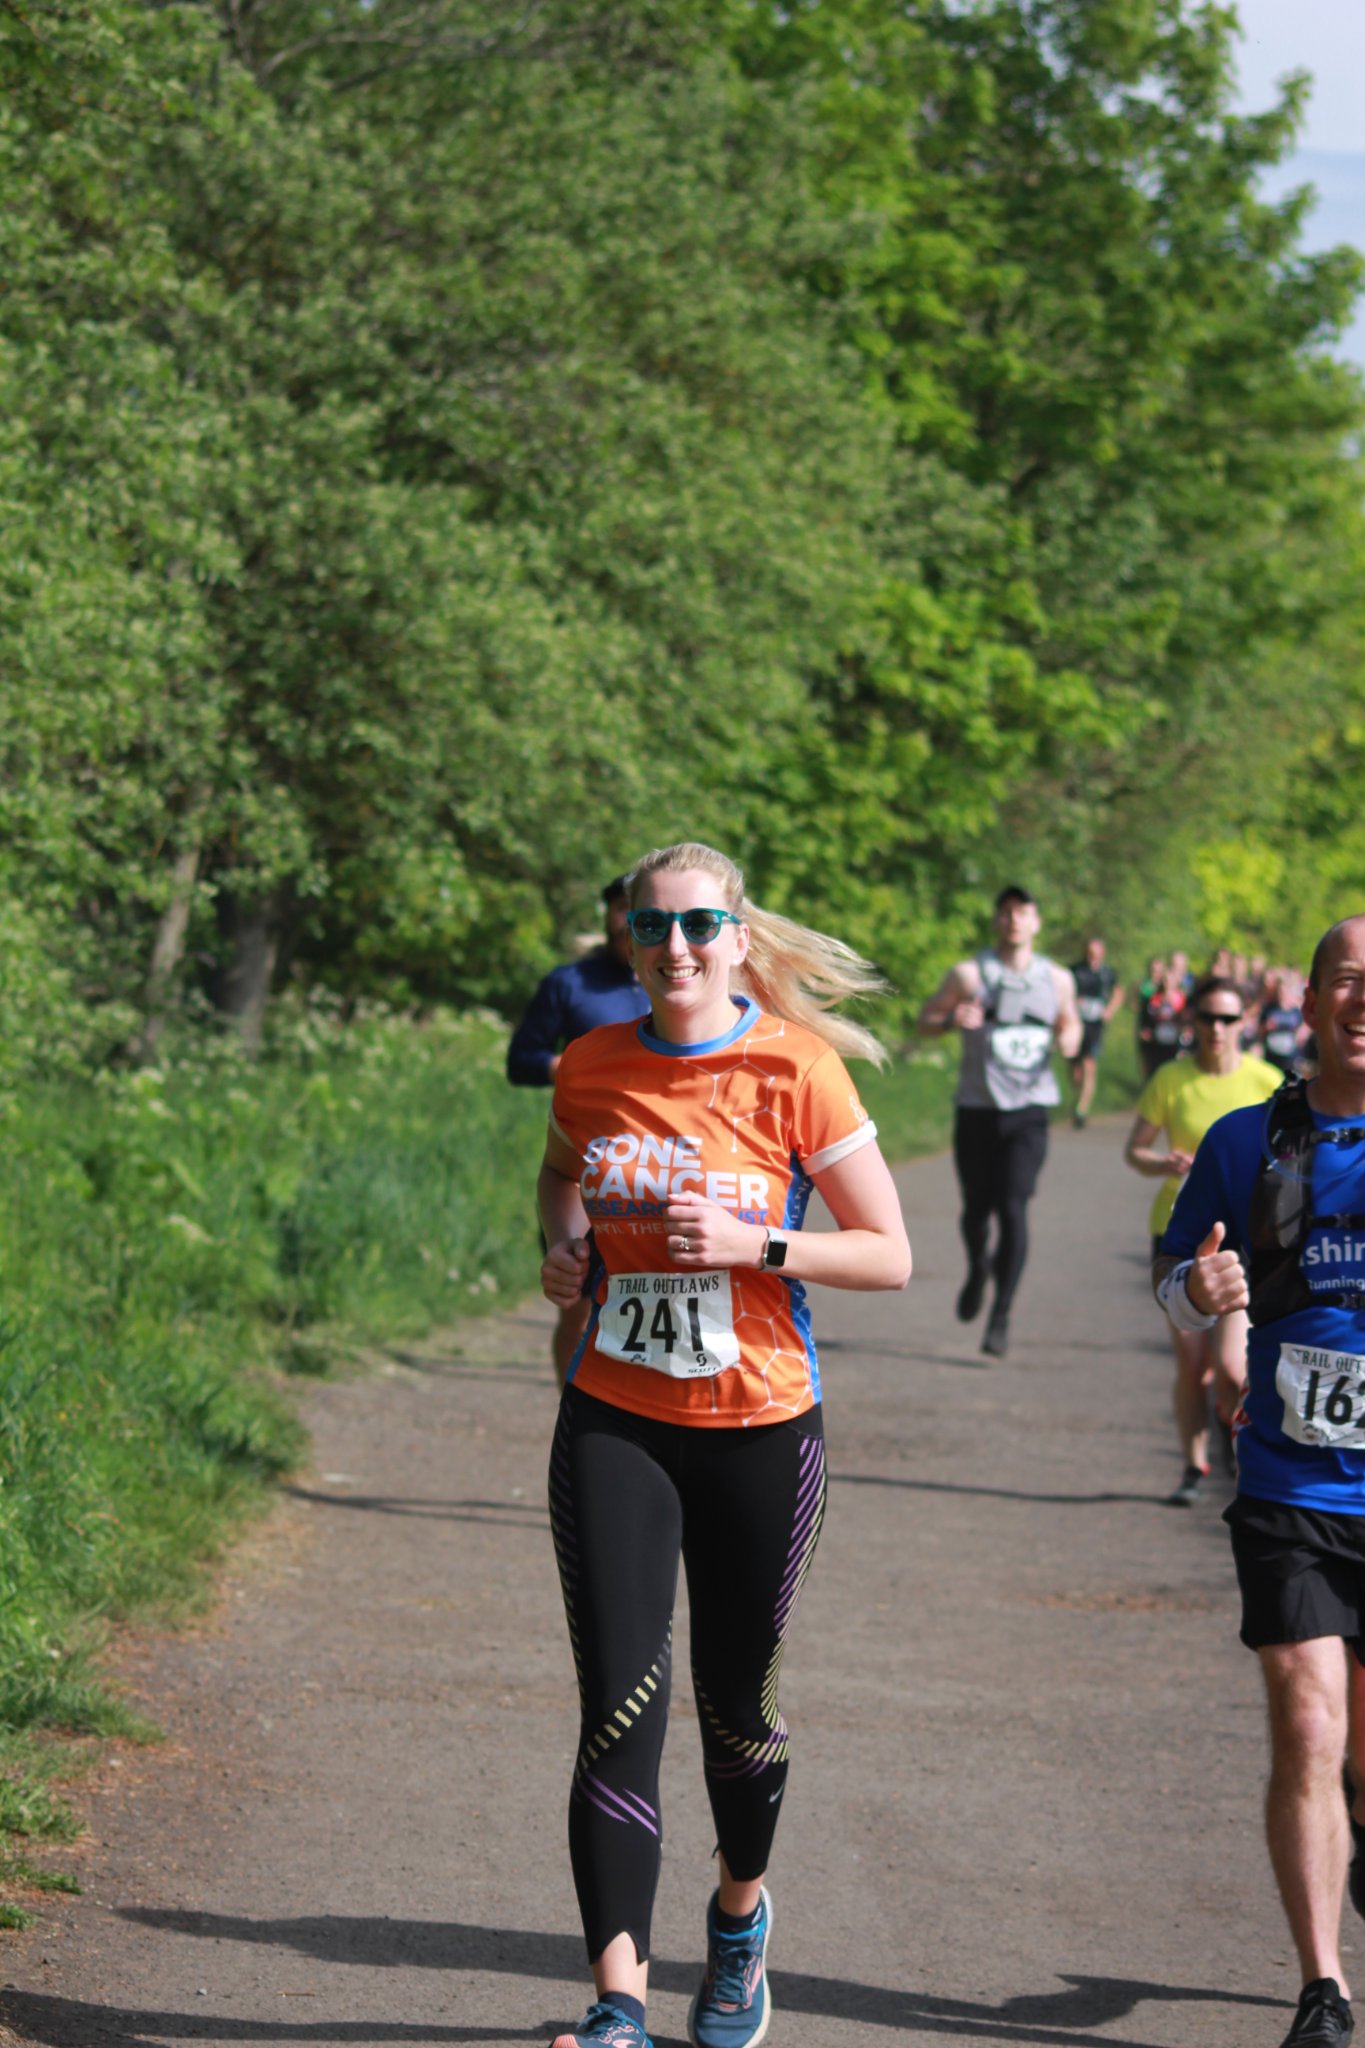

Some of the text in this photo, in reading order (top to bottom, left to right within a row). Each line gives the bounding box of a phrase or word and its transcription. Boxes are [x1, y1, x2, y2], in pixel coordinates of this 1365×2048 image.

[583, 1133, 703, 1169] BONE
[580, 1164, 769, 1209] CANCER
[618, 1275, 720, 1295] TRAIL OUTLAWS
[619, 1297, 704, 1353] 241
